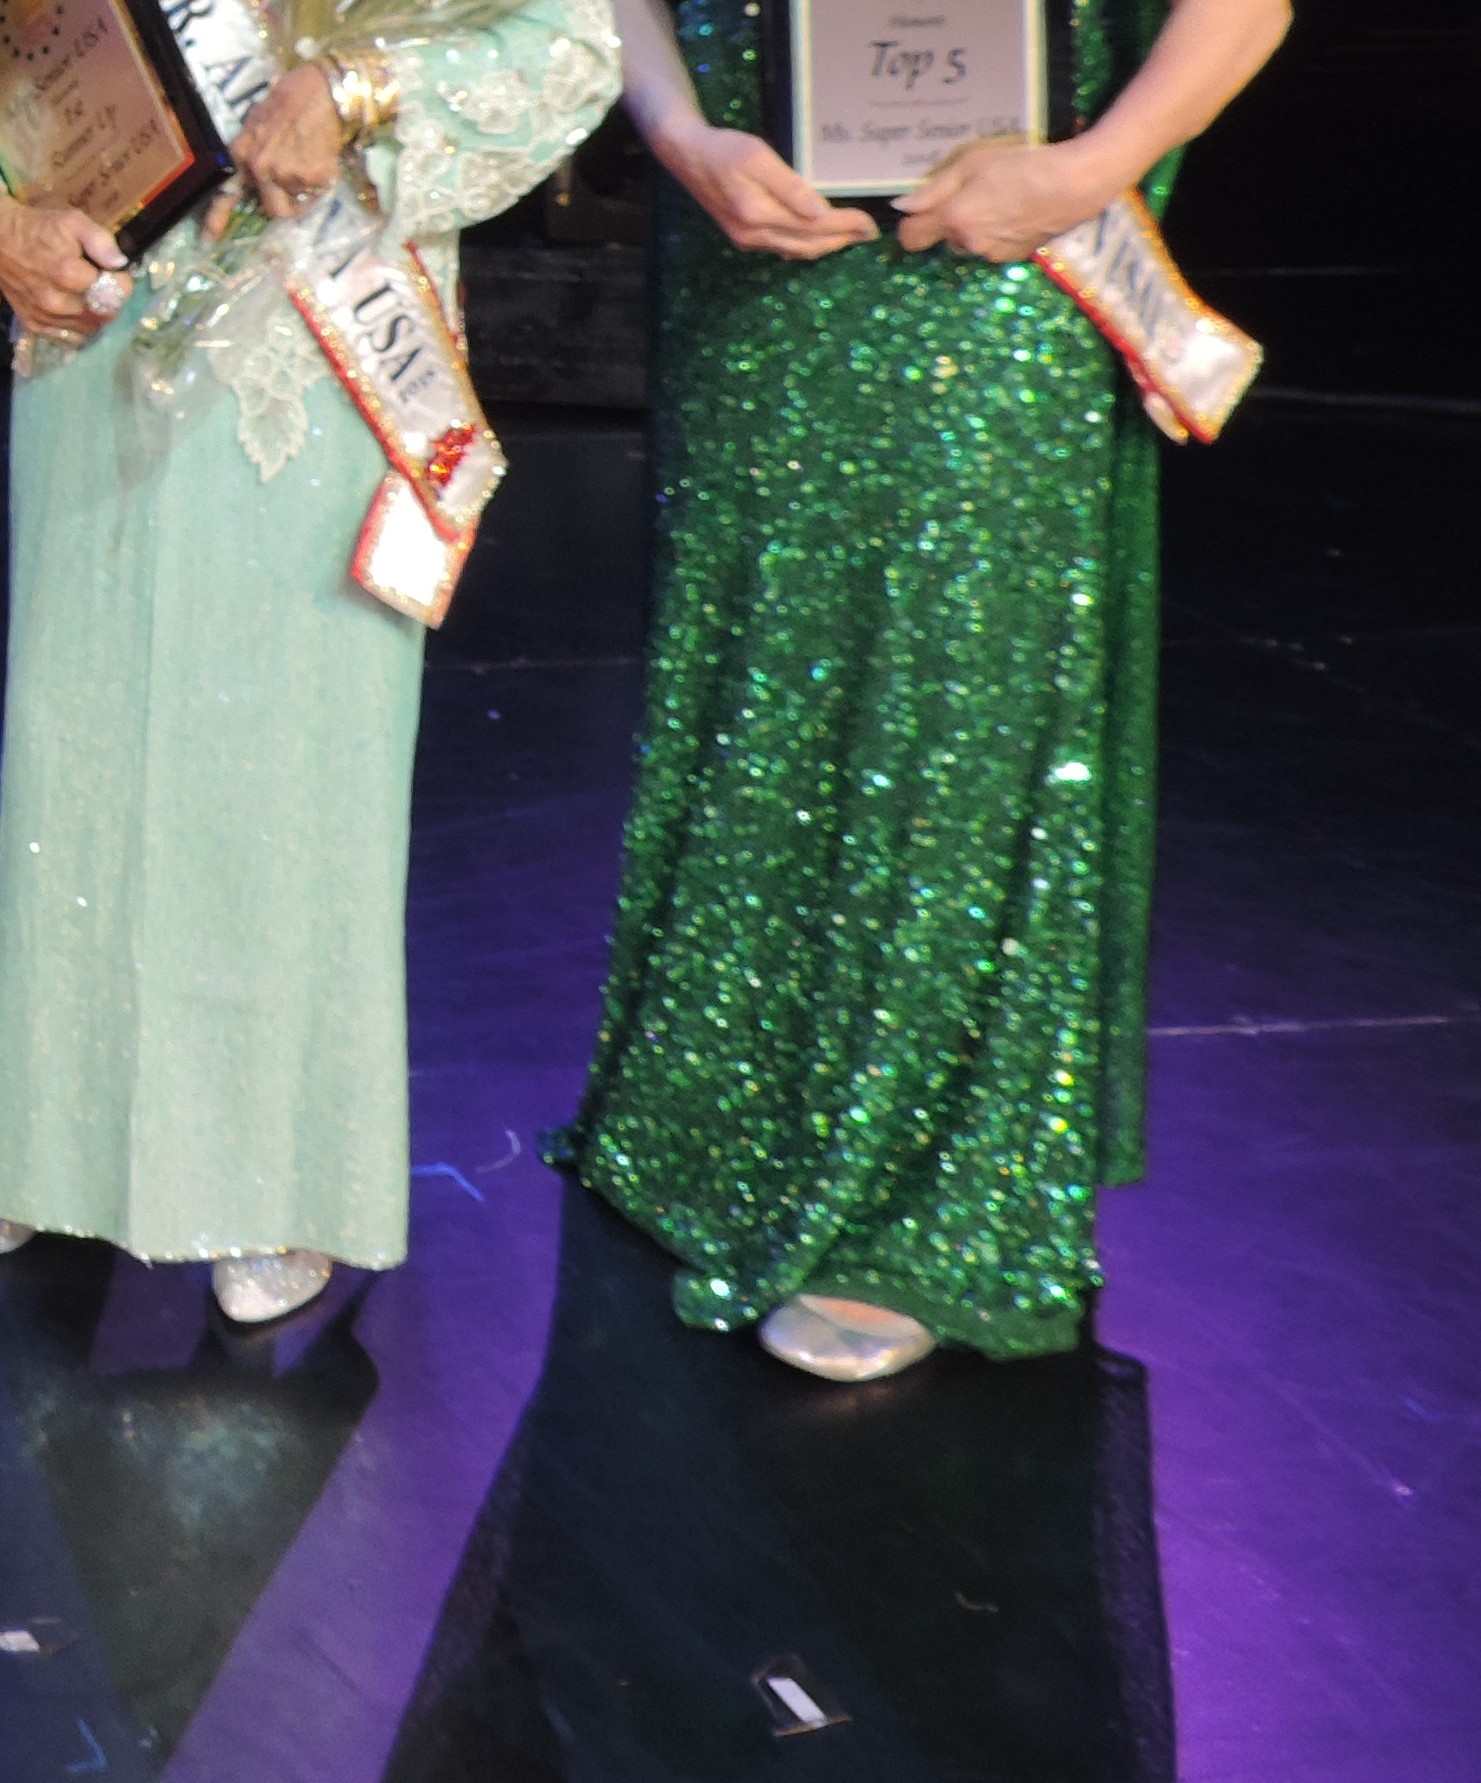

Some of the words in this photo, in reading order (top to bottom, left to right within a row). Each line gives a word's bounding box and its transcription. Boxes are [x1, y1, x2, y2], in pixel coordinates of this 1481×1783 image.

[869, 40, 935, 91] Top
[943, 48, 967, 84] 5
[352, 282, 424, 385] USA
